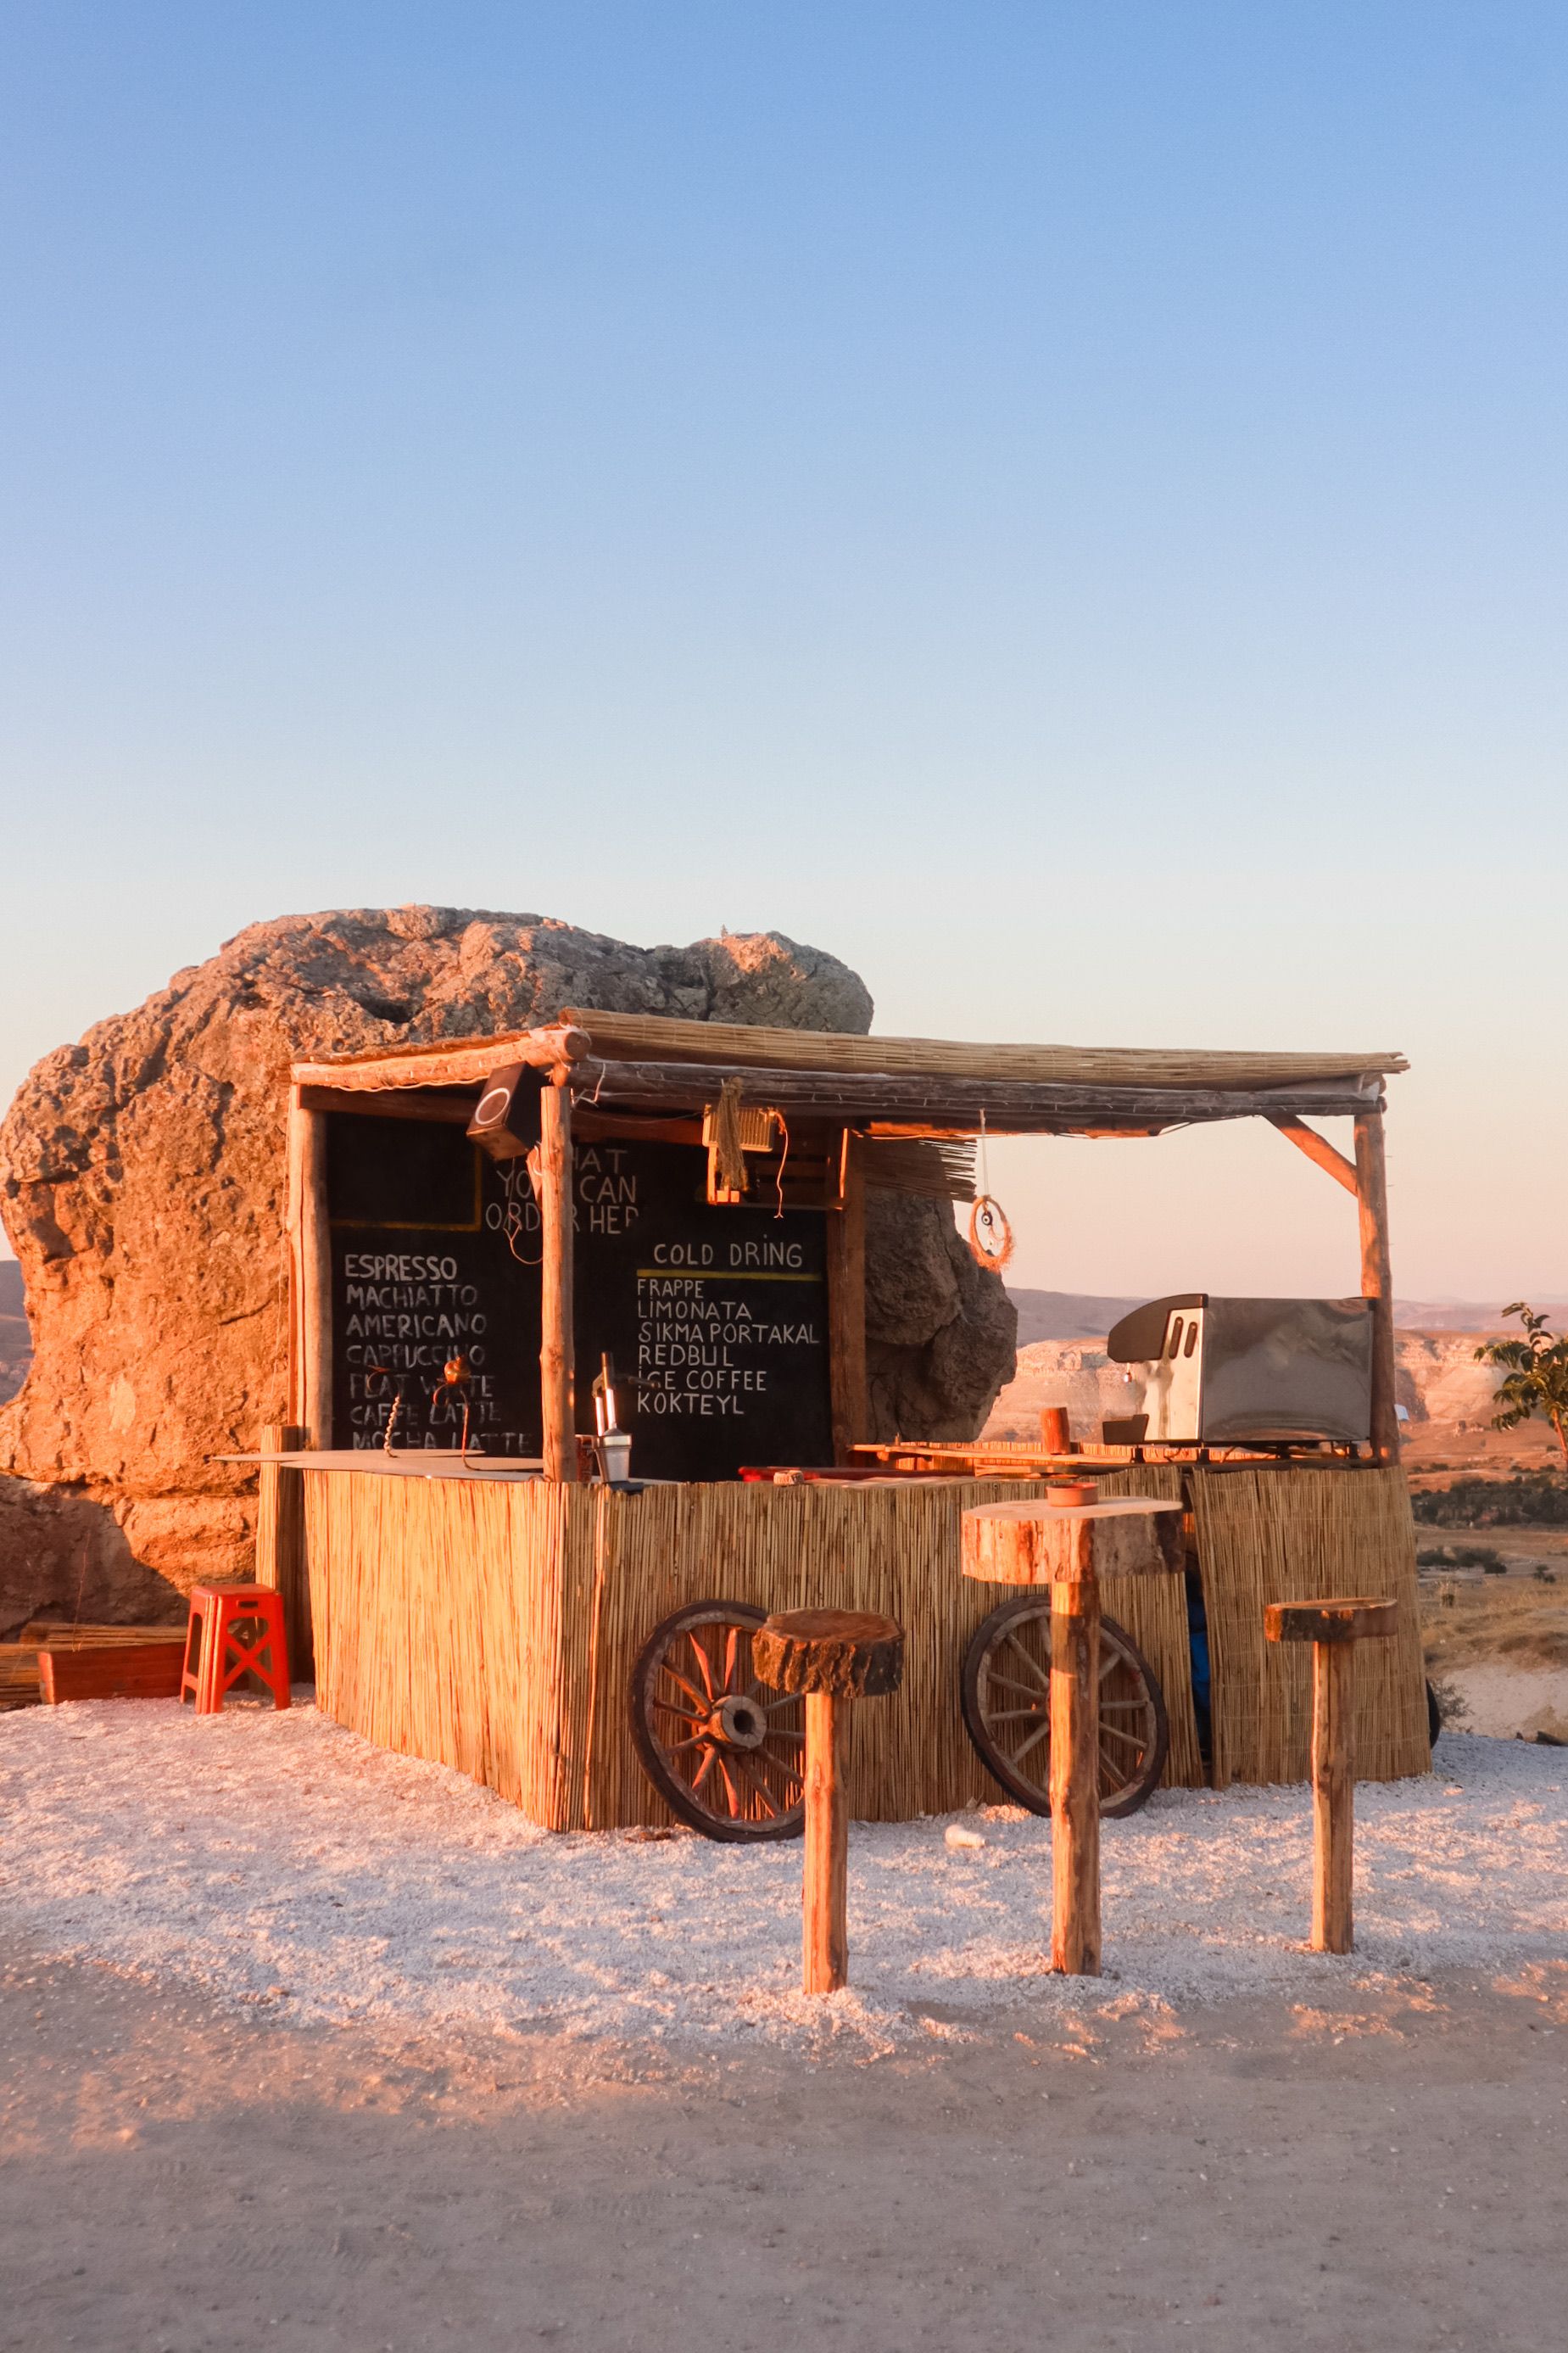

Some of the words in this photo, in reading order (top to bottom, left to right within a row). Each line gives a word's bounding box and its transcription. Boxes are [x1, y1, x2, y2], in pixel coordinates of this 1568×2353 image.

[572, 1147, 628, 1174] HAT
[496, 1170, 532, 1199] YO
[579, 1176, 636, 1204] CAN
[485, 1202, 580, 1232] ORDR
[344, 1254, 458, 1282] ESPRESSO
[653, 1244, 714, 1266] COLD
[346, 1283, 478, 1311] MACHIATTO
[637, 1278, 705, 1299] FRAPPE
[345, 1314, 488, 1339] AMERICANO
[638, 1322, 704, 1343] SIKMA
[710, 1323, 821, 1344] PORTAKAL
[639, 1344, 734, 1367] REDBUL
[349, 1372, 411, 1399] FLAT
[420, 1375, 496, 1398] WTE
[686, 1370, 767, 1391] COFFEE
[349, 1403, 419, 1427] CAFFE
[428, 1400, 502, 1426] LATTE
[637, 1391, 745, 1415] KOKTEYL
